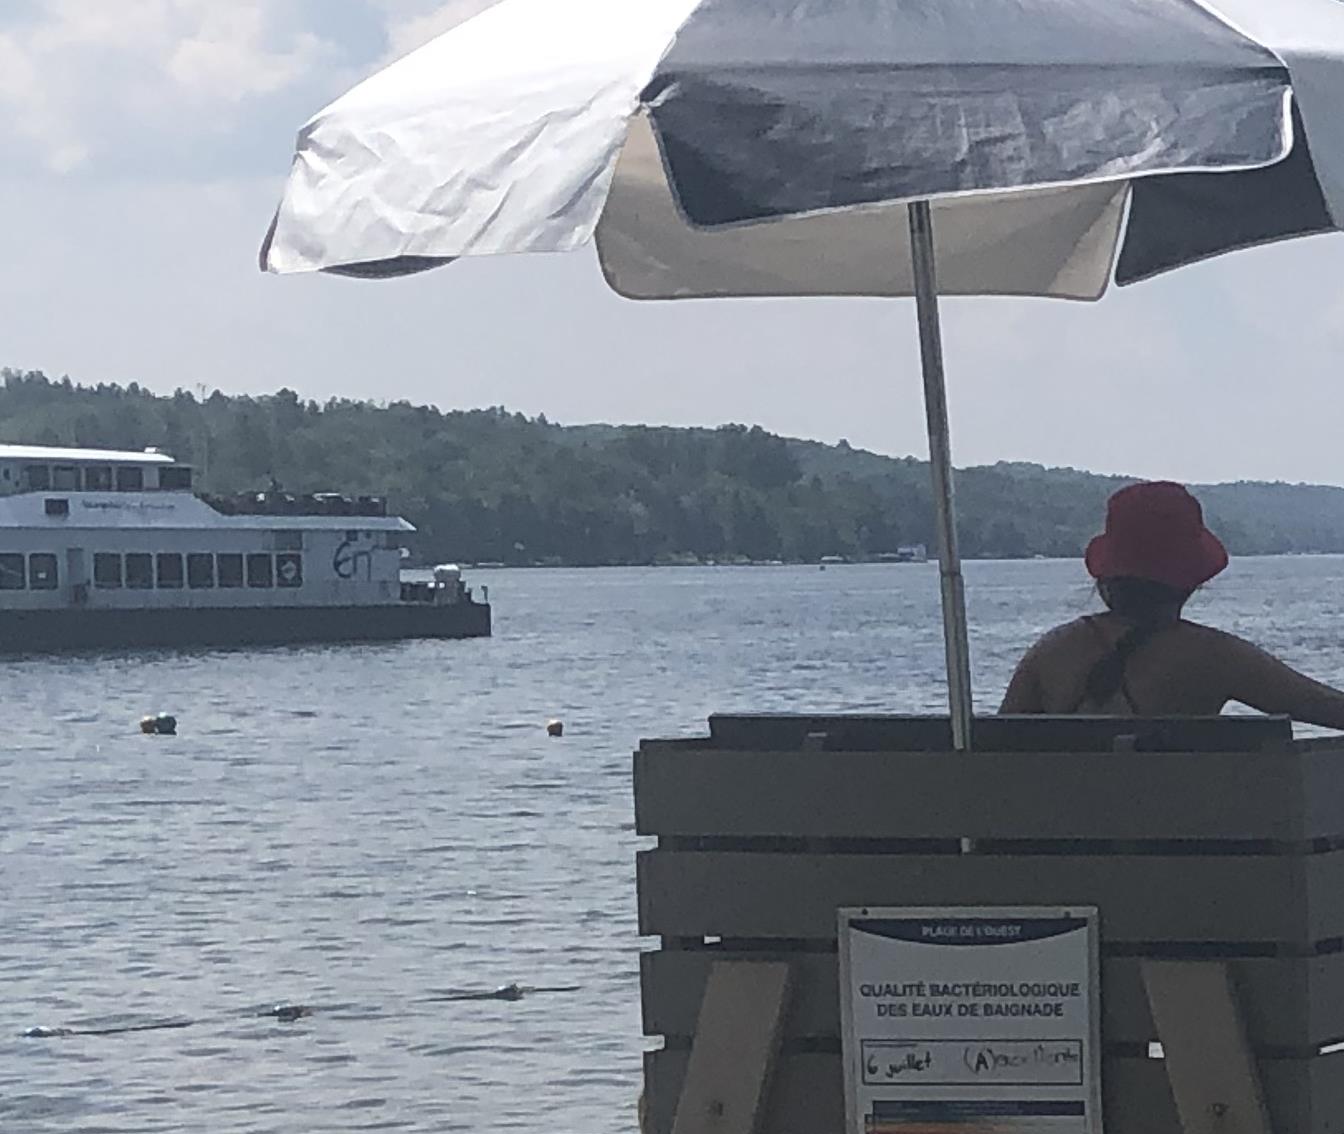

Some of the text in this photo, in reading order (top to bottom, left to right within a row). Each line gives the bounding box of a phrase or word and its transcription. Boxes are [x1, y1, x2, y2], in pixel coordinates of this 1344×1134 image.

[860, 981, 1081, 997] QUALITÉ BACTÉRIOLOGIQUE
[876, 1002, 1064, 1018] DES EAUX DE BAIGNADE
[866, 1055, 879, 1075] 6
